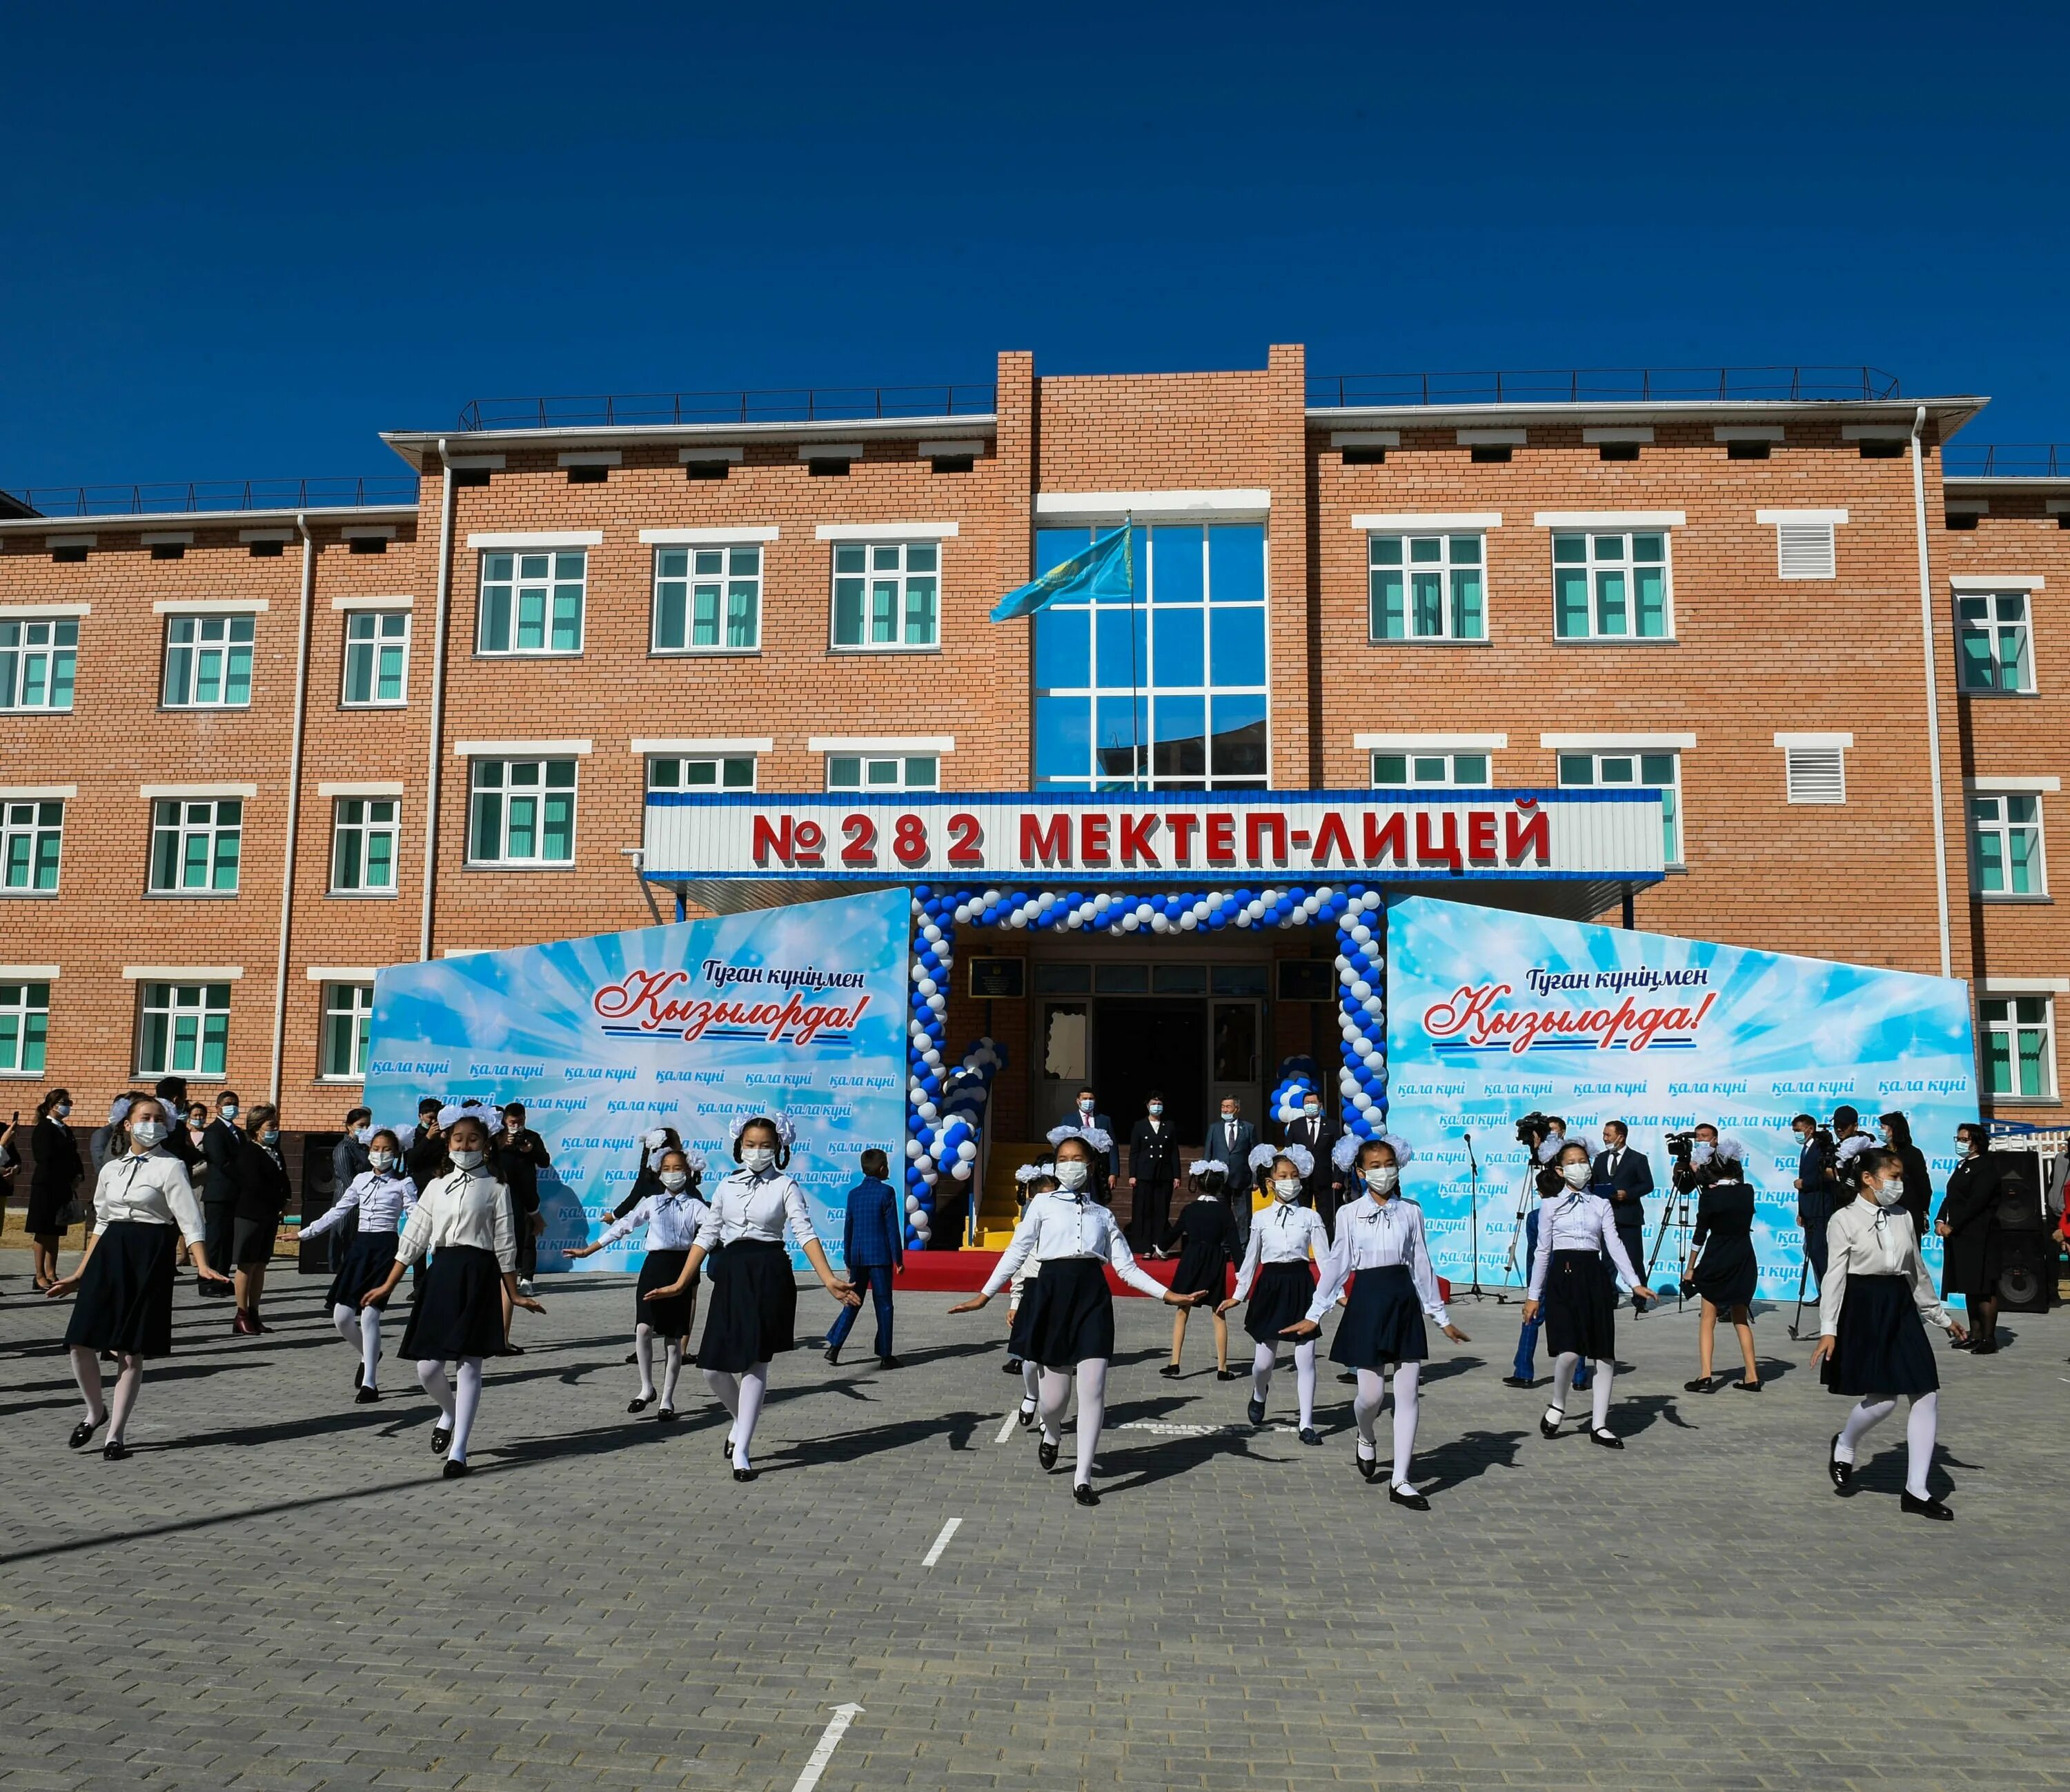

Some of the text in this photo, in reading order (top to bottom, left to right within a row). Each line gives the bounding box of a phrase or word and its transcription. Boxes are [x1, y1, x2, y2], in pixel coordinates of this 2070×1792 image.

[1019, 798, 1549, 869] МЕКТЕП-ЛИЦЕЙ
[702, 959, 761, 989] Туған
[1526, 968, 1590, 996] Туған
[594, 969, 871, 1045] Қызылорда!
[1424, 984, 1717, 1054] Қызылорда!
[373, 1059, 449, 1076] қала күні
[470, 1063, 545, 1080] қала күні
[564, 1066, 637, 1082] қала күні
[656, 1069, 724, 1085] қала күні
[745, 1072, 812, 1088] қала күні
[829, 1074, 896, 1090] қала күні
[1397, 1081, 1466, 1098] қала күні
[1484, 1081, 1552, 1097] қала күні
[1574, 1080, 1647, 1097] қала күні
[1668, 1079, 1747, 1097] қала күні
[1771, 1077, 1855, 1096] қала күні
[1878, 1076, 1966, 1096] қала күні
[555, 1096, 587, 1113] күні
[607, 1099, 679, 1114] қала күні
[697, 1102, 733, 1117] қала
[822, 1103, 851, 1121] күні
[1439, 1112, 1508, 1128] қала күні
[1662, 1112, 1695, 1130] күні
[1717, 1114, 1758, 1130] қала
[562, 1135, 635, 1152] қала күні
[693, 1138, 723, 1154] күні
[791, 1139, 811, 1155] үні
[828, 1141, 862, 1155] қала
[1436, 1150, 1466, 1164] күні
[1485, 1151, 1519, 1165] қала
[1775, 1156, 1798, 1172] қа
[1932, 1158, 1958, 1174] кү
[822, 1170, 851, 1187] күні
[1478, 1181, 1508, 1199] күні
[1766, 1191, 1798, 1208] күн
[827, 1209, 845, 1222] қа
[1436, 1217, 1467, 1232] күні
[1777, 1232, 1802, 1247] қа
